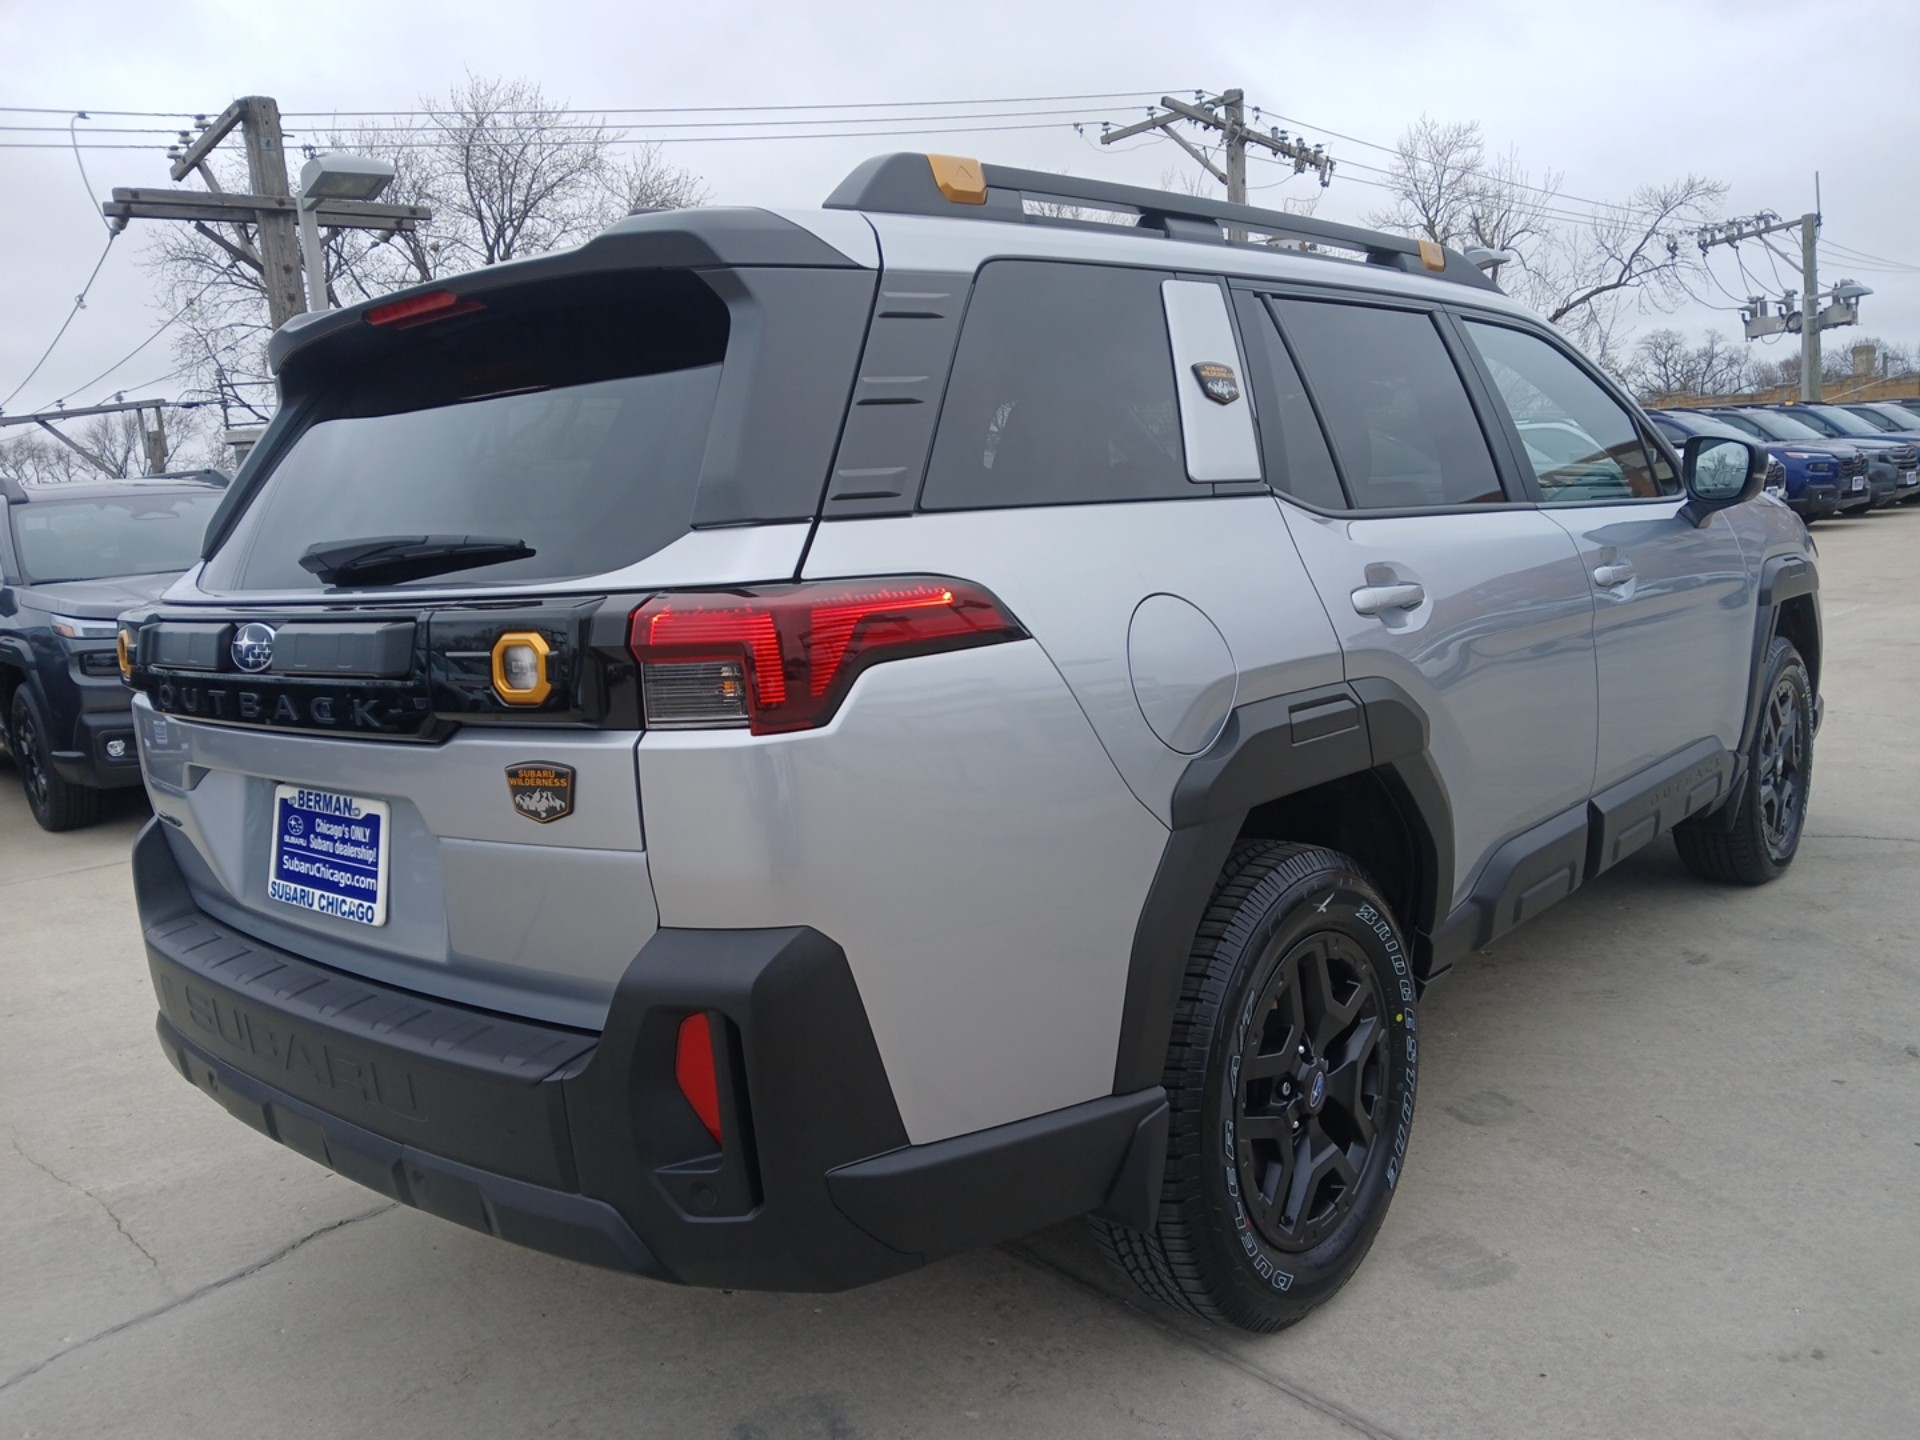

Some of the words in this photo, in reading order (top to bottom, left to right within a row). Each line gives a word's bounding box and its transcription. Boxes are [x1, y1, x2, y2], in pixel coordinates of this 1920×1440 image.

[159, 684, 381, 728] OUTBACK
[510, 778, 567, 787] WILDERNESS
[518, 769, 556, 778] SUBARU
[298, 789, 353, 817] BERMAN
[283, 834, 307, 847] SUBARU
[315, 818, 349, 839] Chicago's
[350, 825, 371, 843] ONLY
[309, 834, 334, 854] Subaru
[334, 840, 377, 865] dealership!
[282, 855, 377, 891] SubaruChicago.com
[270, 881, 315, 909] SUBARU
[317, 893, 375, 923] CHICAGO
[184, 985, 429, 1123] SUBARU
[1355, 903, 1417, 1190] BRIDGESTONE
[1224, 1119, 1294, 1291] DUELER
